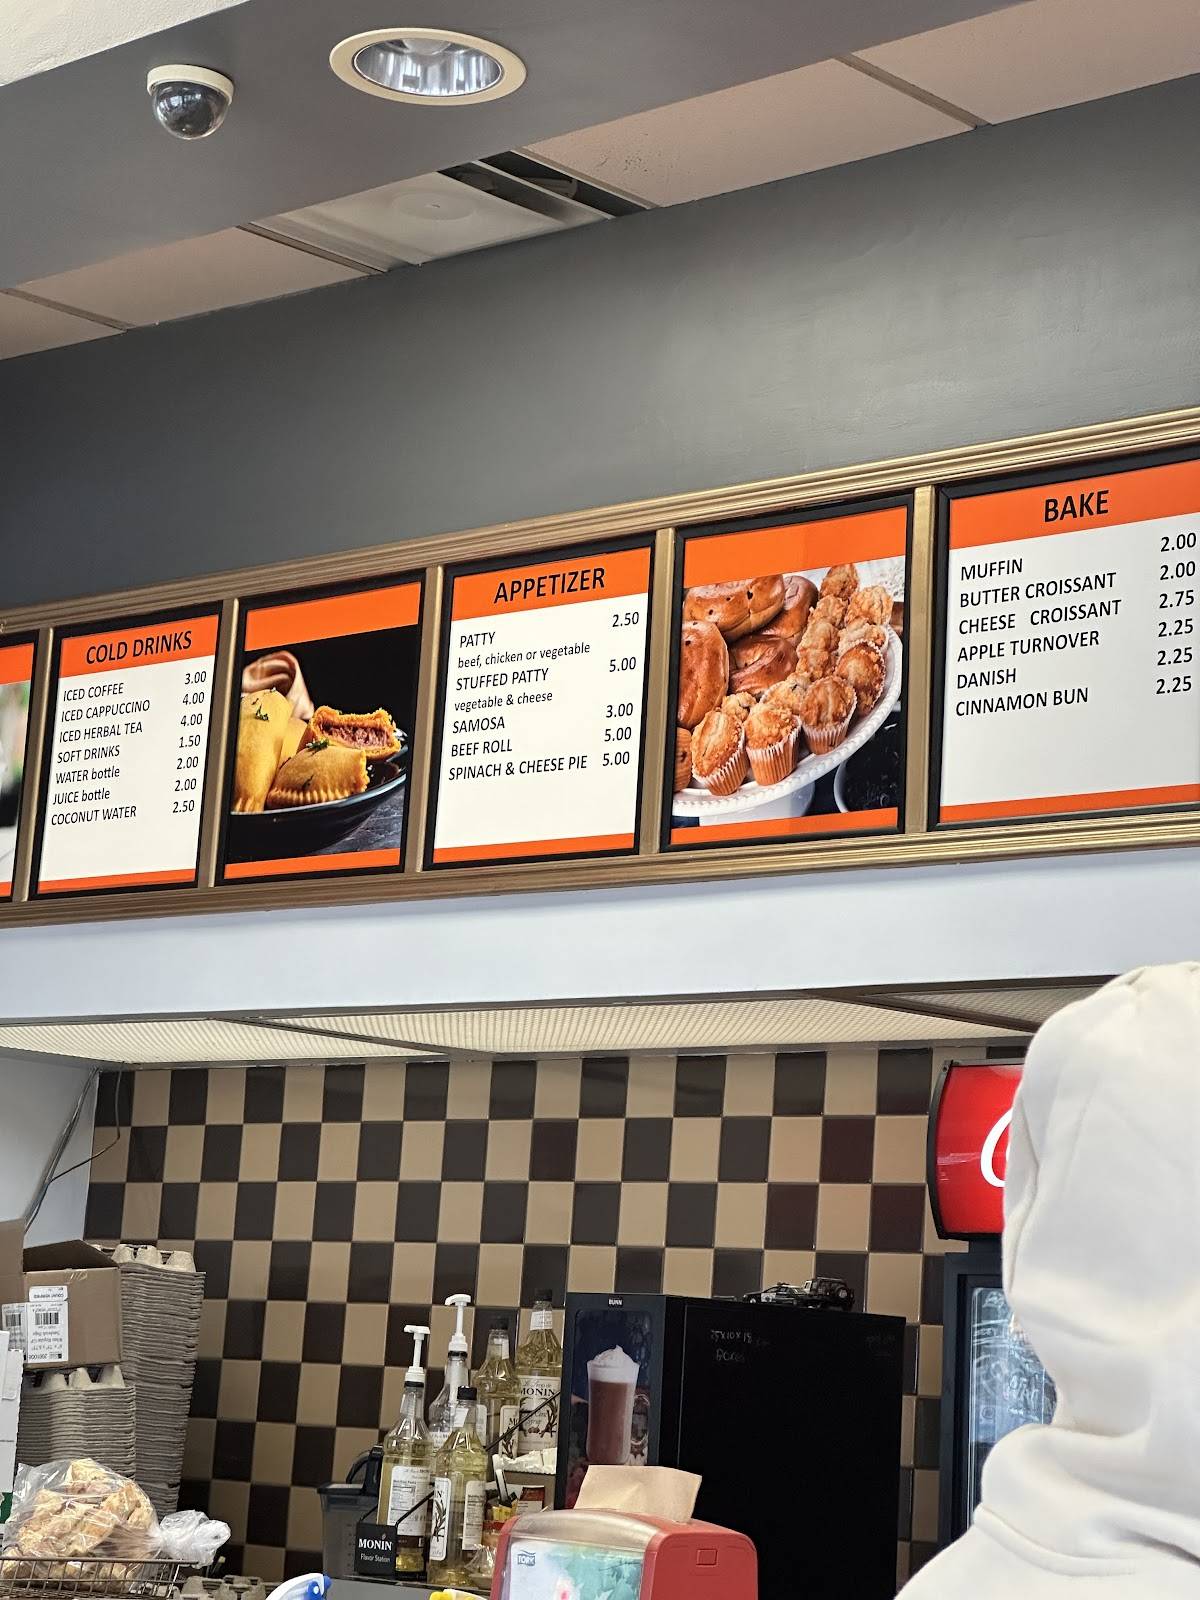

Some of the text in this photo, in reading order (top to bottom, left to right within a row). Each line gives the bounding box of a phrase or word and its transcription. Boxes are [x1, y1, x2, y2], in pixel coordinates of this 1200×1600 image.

[1045, 490, 1109, 523] BAKE
[1161, 532, 1196, 552] 2.00
[961, 558, 1022, 581] MUFFIN
[1160, 561, 1195, 580] 2.00
[494, 567, 605, 604] APPETIZER
[960, 572, 1117, 608] BUTTER CROISSANT
[1159, 589, 1194, 609] 2.75
[612, 611, 639, 627] 2.50
[959, 599, 1122, 635] CHEESE CROISSANT
[1158, 618, 1193, 637] 2.25
[86, 630, 192, 664] COLD DRINKS
[460, 631, 496, 648] PATTY
[957, 630, 1099, 662] APPLE TURNOVER
[458, 642, 590, 668] beef, chicken or vegetable
[609, 657, 636, 672] 5.00
[1157, 647, 1192, 666] 2.25
[185, 671, 206, 685] 3.00
[456, 668, 549, 691] STUFFED PATTY
[957, 668, 1016, 689] DANISH
[1156, 675, 1191, 694] 2.25
[63, 682, 124, 702] ICED COFFEE
[182, 691, 204, 705] 4.00
[956, 687, 1088, 716] CINNAMON BUN
[61, 700, 150, 722] ICED CAPPUCCINO
[454, 692, 553, 713] vegetable & cheese
[606, 702, 633, 718] 3.00
[180, 713, 203, 727] 4.00
[453, 716, 505, 734] SAMOSA
[59, 721, 142, 743] ICED HERBAL TEA
[179, 734, 201, 748] 1.50
[604, 726, 632, 742] 5.00
[57, 745, 120, 764] SOFT DRINKS
[451, 739, 512, 757] BEEF ROLL
[177, 756, 199, 770] 2.00
[448, 755, 587, 781] SPINACH & CHEESE PIE
[602, 751, 630, 766] 5.00
[56, 765, 120, 784] WATER bottle
[174, 778, 197, 792] 2.00
[53, 787, 110, 805] JUICE bottle
[173, 799, 195, 813] 2.50
[51, 806, 136, 826] COCONUT WATER
[358, 1538, 392, 1551] MONIN
[360, 1553, 391, 1563] Flavor Station
